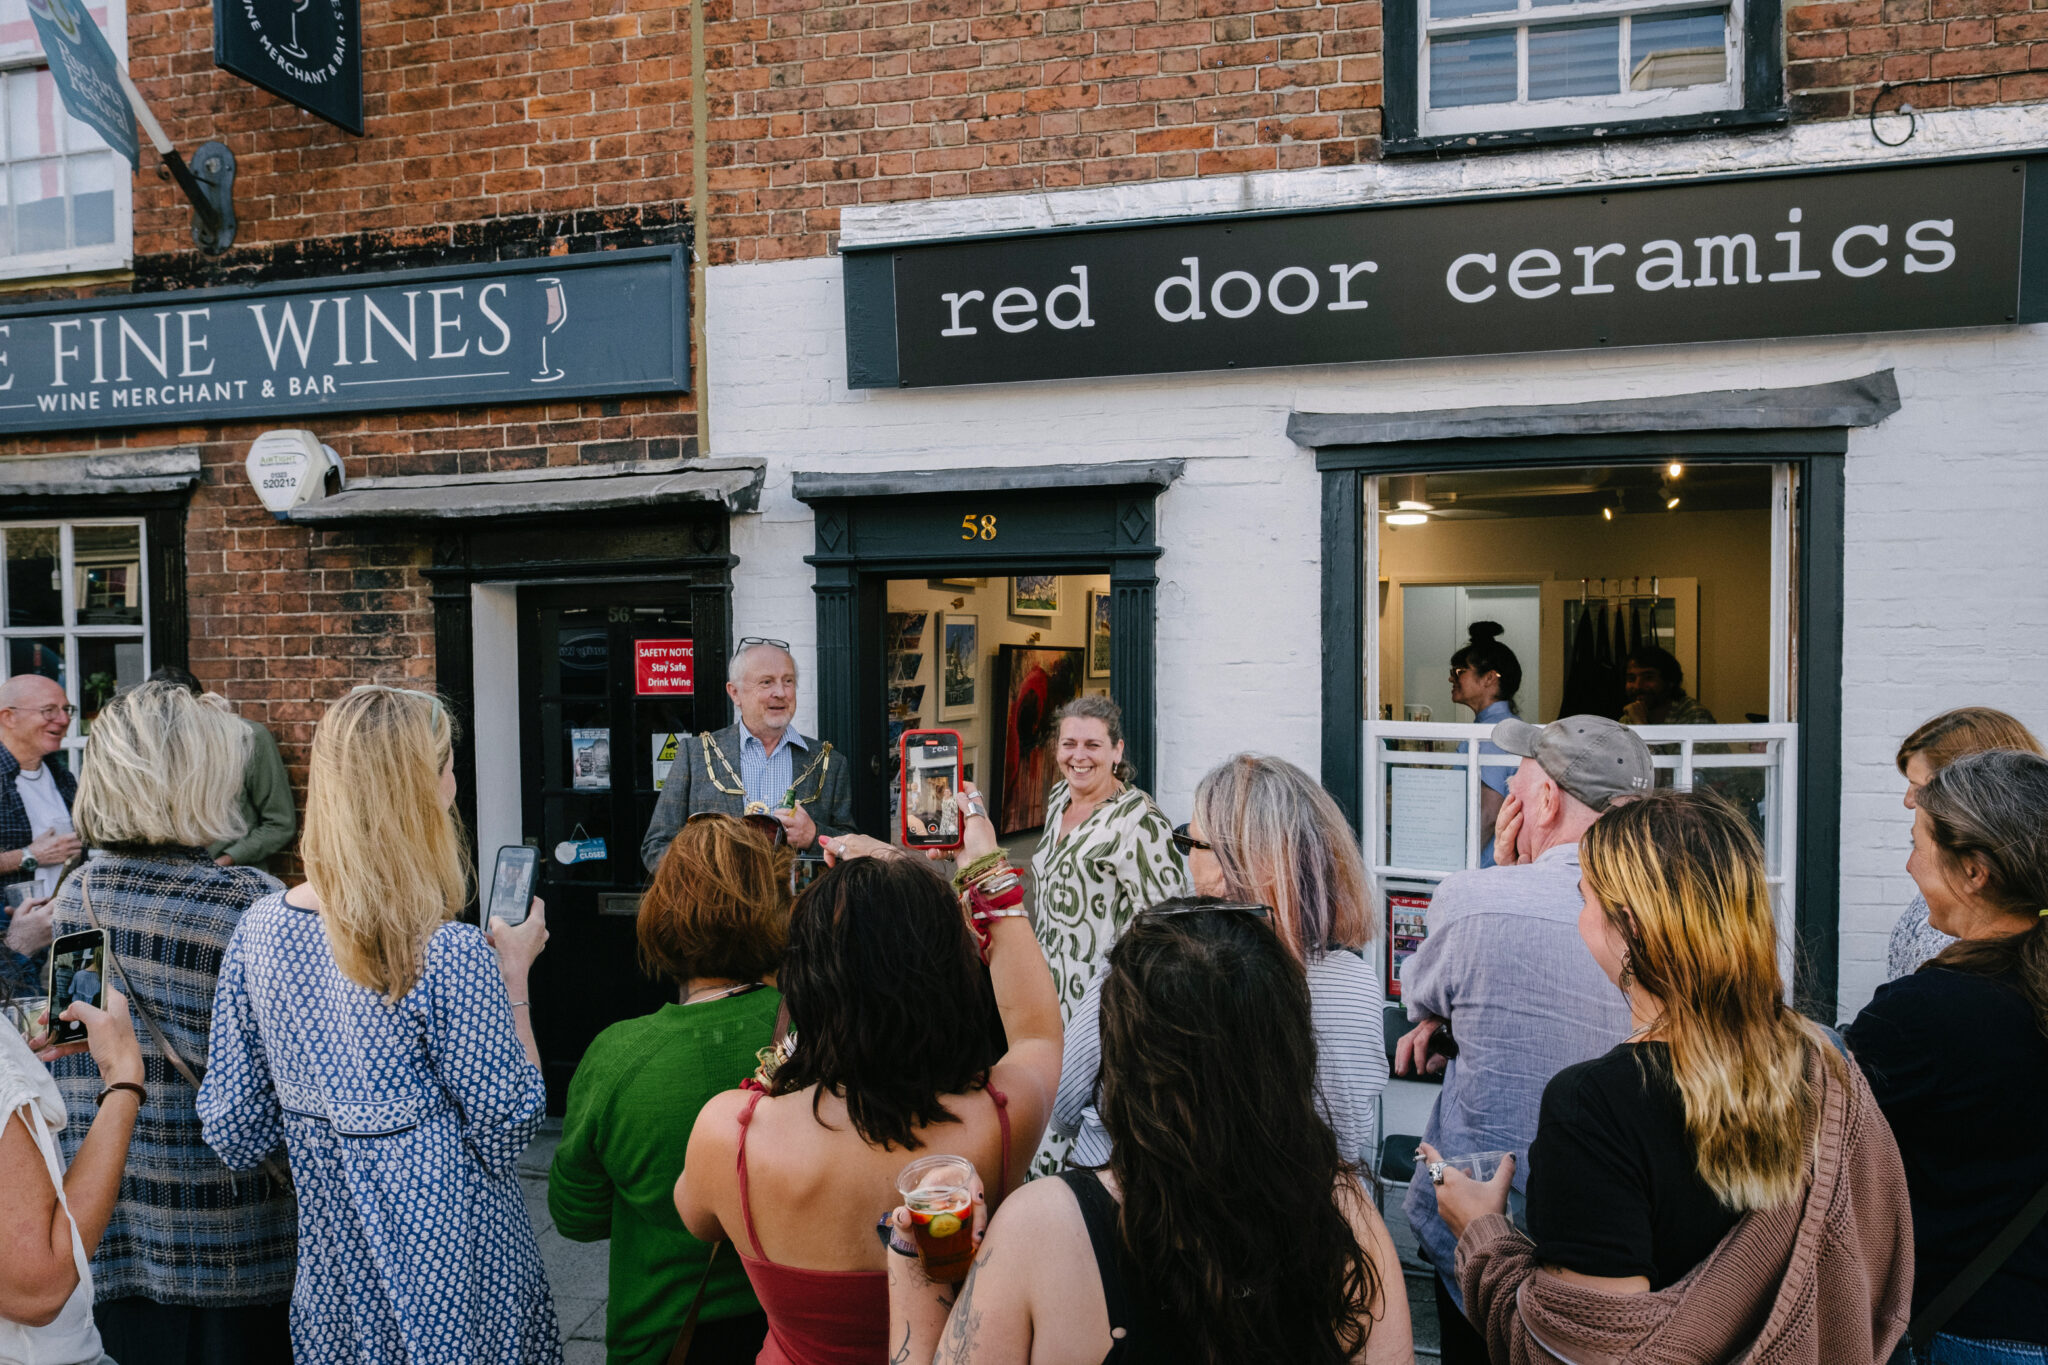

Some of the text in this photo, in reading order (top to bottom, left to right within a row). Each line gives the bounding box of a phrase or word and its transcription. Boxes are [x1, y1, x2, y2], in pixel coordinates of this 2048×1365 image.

[242, 0, 346, 84] INE MERCHANT & BAR
[940, 207, 1956, 337] red door ceramics
[49, 308, 215, 386] FINE
[247, 283, 511, 371] WINES
[37, 375, 336, 412] WINE MERCHANT & BAR
[263, 478, 297, 488] 520212
[961, 514, 998, 541] 58
[607, 606, 630, 623] 56
[639, 648, 694, 657] SAFETY NOTIC
[651, 662, 687, 674] Stay Safe
[648, 677, 691, 687] Drink Wine
[580, 851, 606, 860] CLOSED
